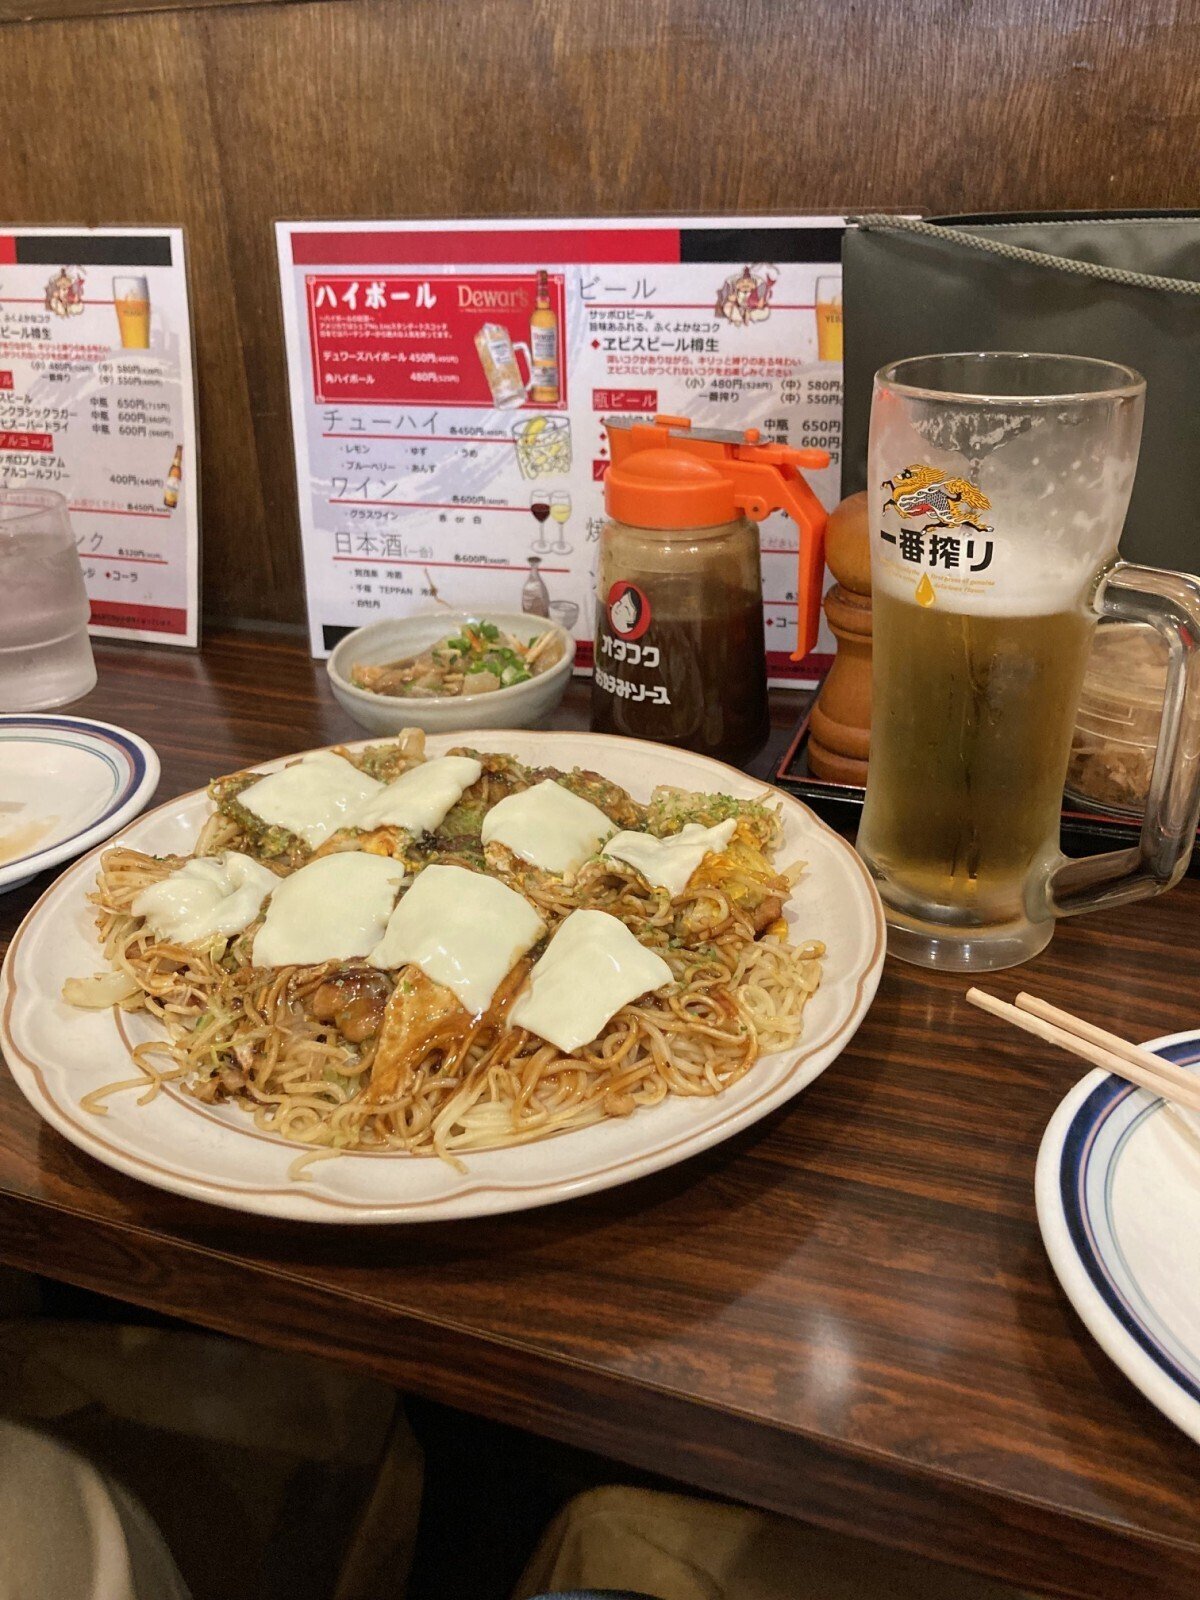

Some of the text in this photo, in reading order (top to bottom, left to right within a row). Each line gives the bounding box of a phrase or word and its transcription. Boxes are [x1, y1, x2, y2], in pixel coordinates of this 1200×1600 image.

[315, 281, 437, 310] ハイボール
[579, 278, 657, 300] ビール
[589, 310, 654, 320] サッポロビール
[323, 410, 438, 433] チューハイ
[764, 418, 841, 433] 中瓶 650円
[802, 436, 840, 449] 600円
[332, 476, 398, 498] ワイン
[880, 528, 994, 572] 一番搾り
[601, 634, 660, 668] オタフク
[594, 667, 672, 705] お好みソース
